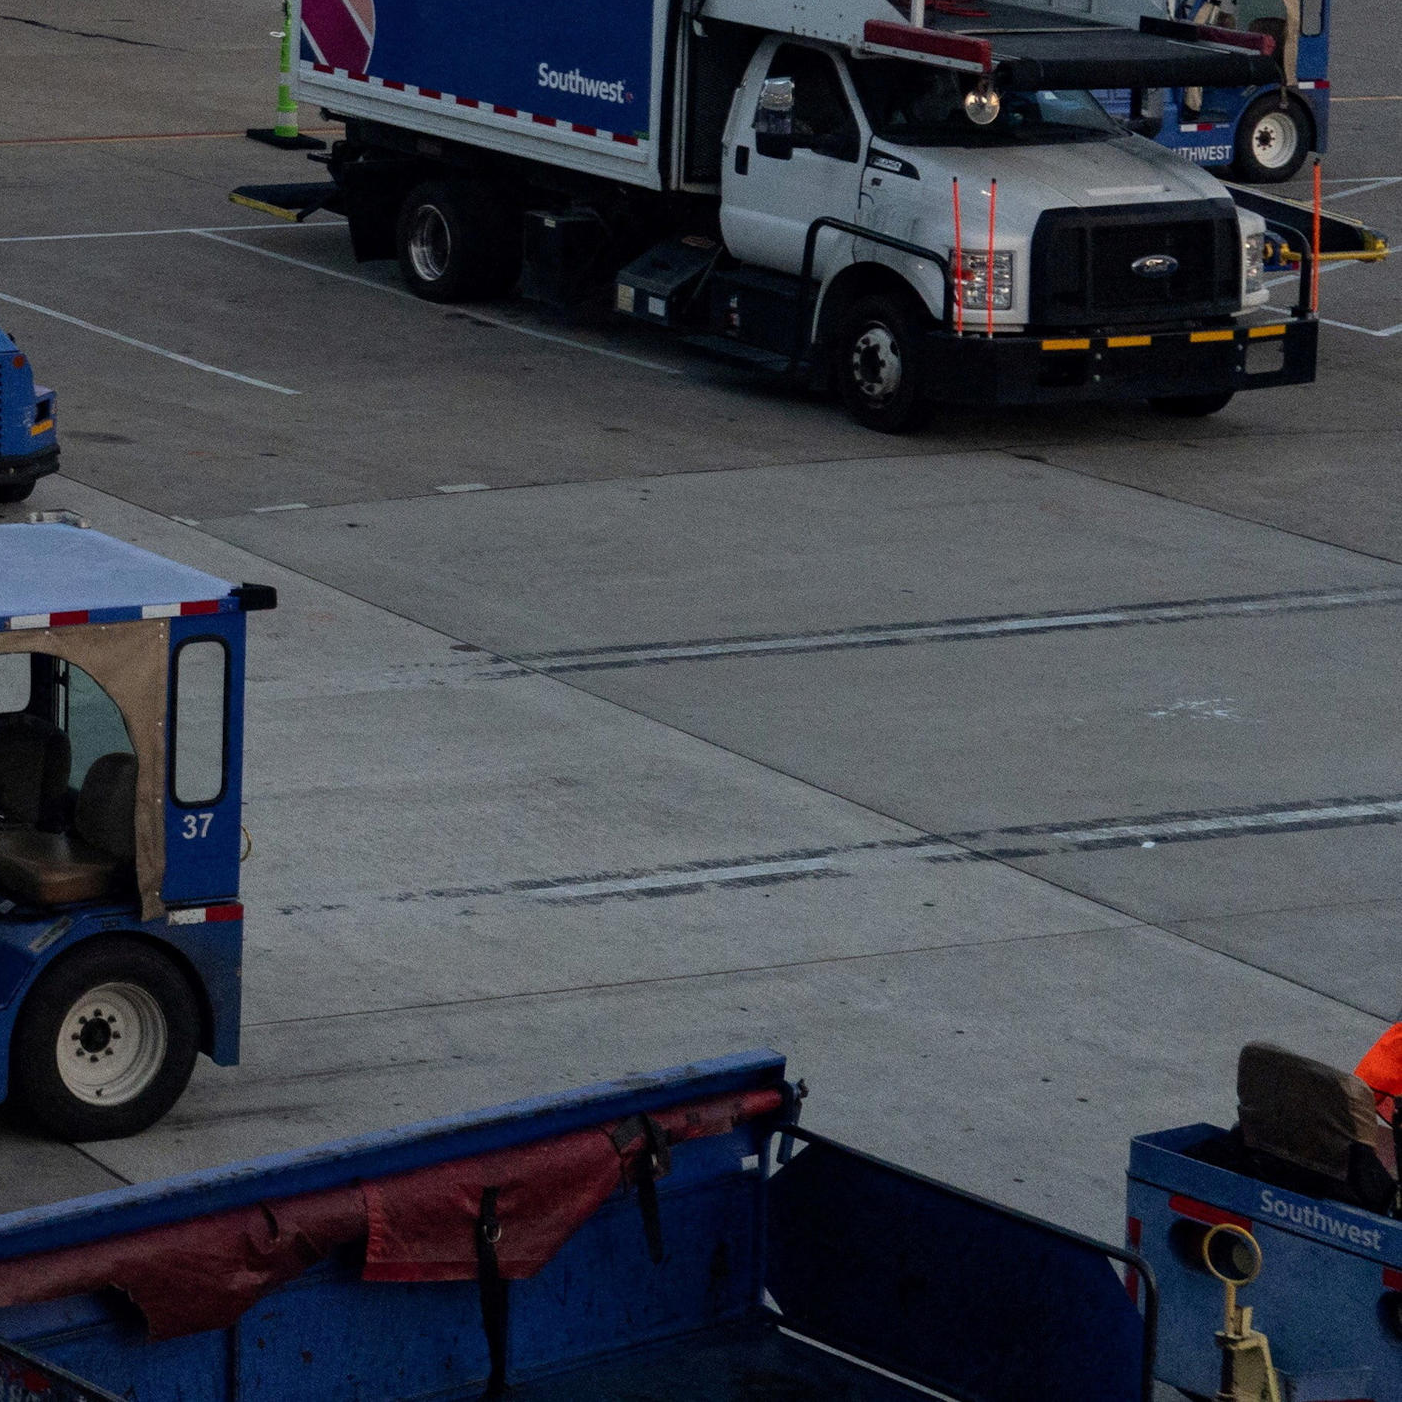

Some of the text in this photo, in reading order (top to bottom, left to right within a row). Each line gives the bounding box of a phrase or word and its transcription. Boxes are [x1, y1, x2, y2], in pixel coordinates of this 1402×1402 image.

[538, 62, 624, 104] Southwest
[182, 812, 215, 840] 37
[1260, 1189, 1385, 1252] Southwest
